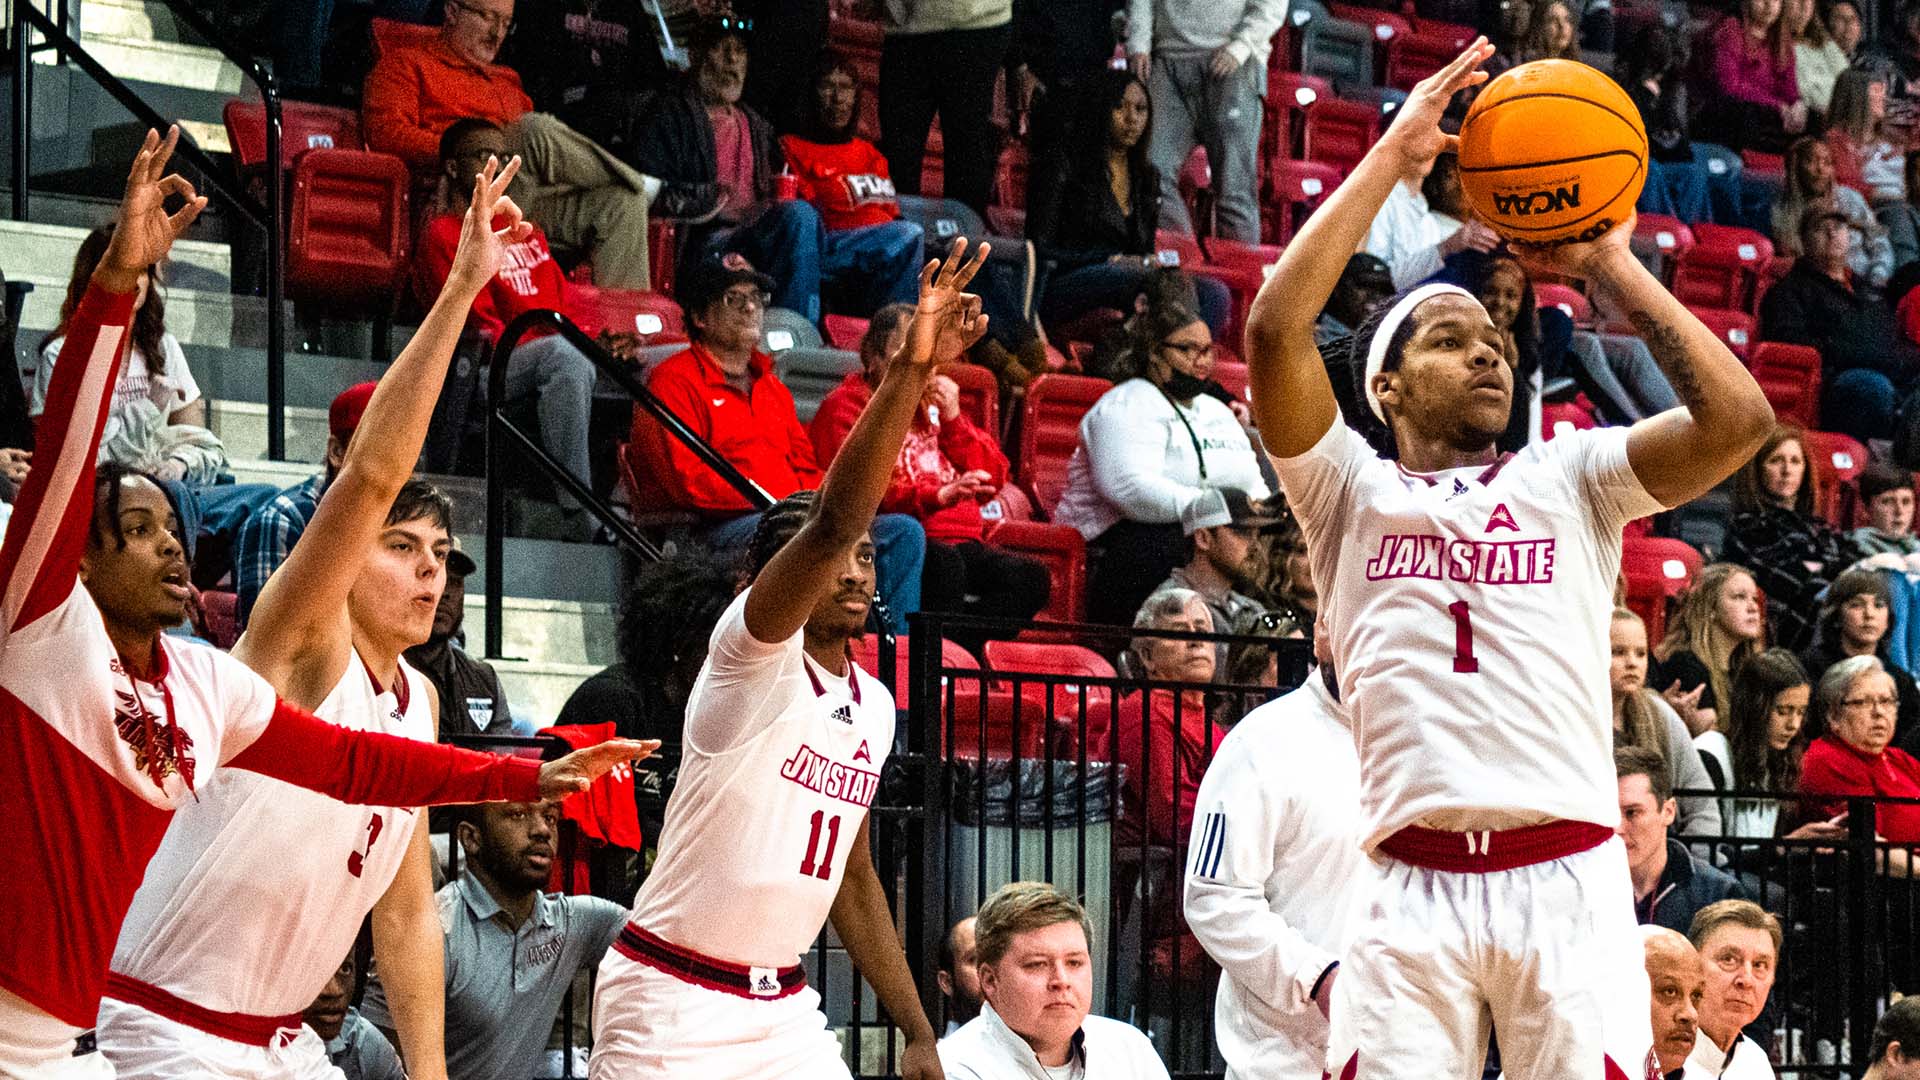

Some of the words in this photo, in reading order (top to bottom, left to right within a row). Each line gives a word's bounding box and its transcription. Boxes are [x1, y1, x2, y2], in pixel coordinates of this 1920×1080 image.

[1493, 183, 1581, 216] NCAA
[1366, 535, 1445, 581] JAX
[1449, 538, 1555, 584] STATE
[1449, 601, 1479, 673] 1
[830, 712, 853, 725] adidas
[781, 744, 830, 793] JAX
[800, 810, 841, 881] 11
